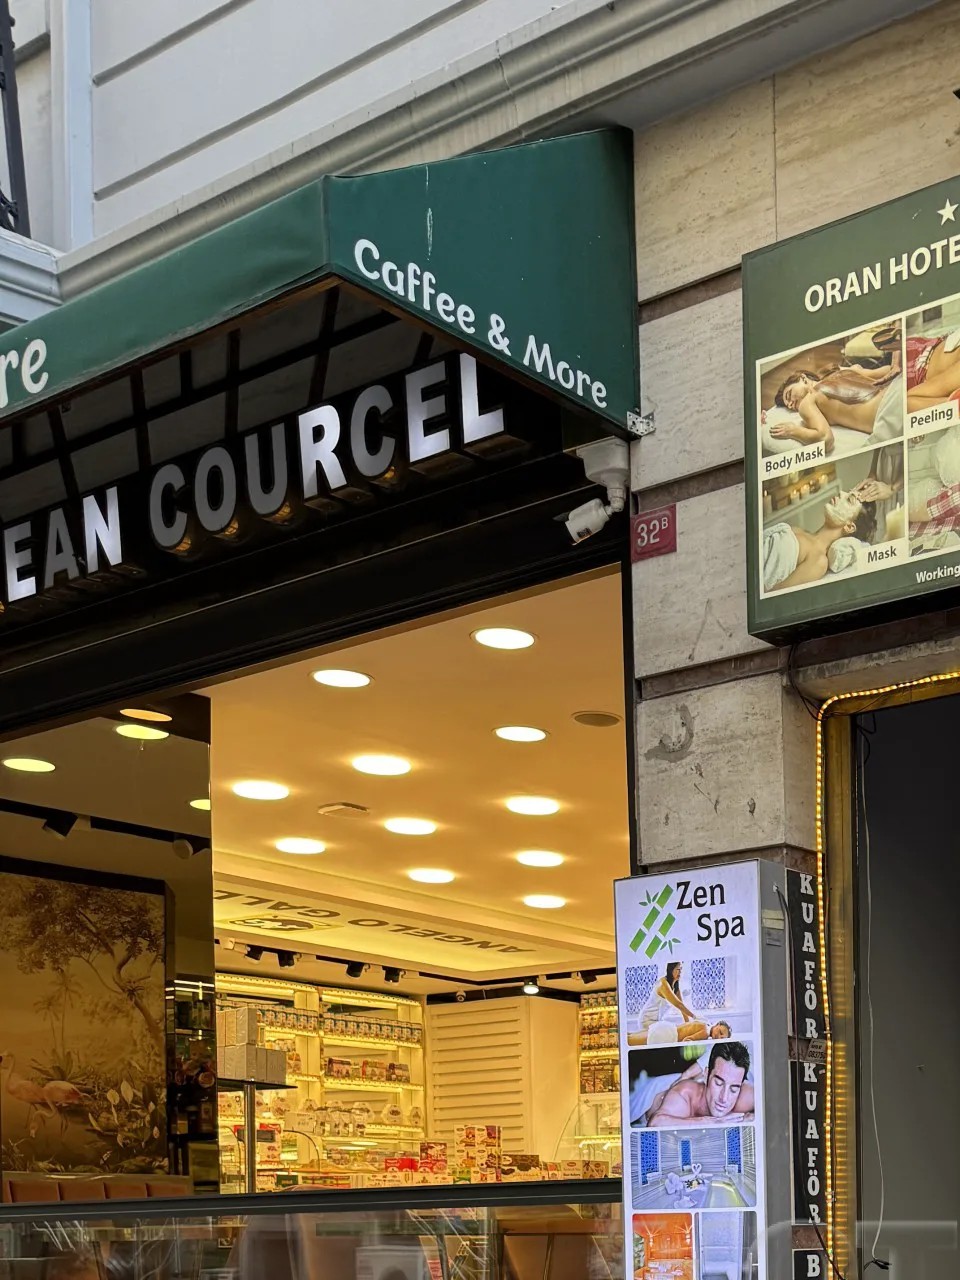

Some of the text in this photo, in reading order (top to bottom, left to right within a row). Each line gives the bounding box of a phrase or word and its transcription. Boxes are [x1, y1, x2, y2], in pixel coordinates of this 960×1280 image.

[803, 262, 883, 313] ORAN
[354, 238, 607, 409] Caffee & More
[910, 406, 954, 428] Peeling
[4, 351, 505, 602] EAN COURCEL
[765, 445, 824, 473] Body Mask
[867, 546, 897, 564] Mask
[916, 564, 960, 584] Working
[676, 880, 726, 910] Zen
[347, 918, 537, 954] ANGELO
[696, 912, 745, 947] Spa
[800, 872, 819, 1039] KUAFÖR
[803, 1062, 821, 1224] KUAFÖR
